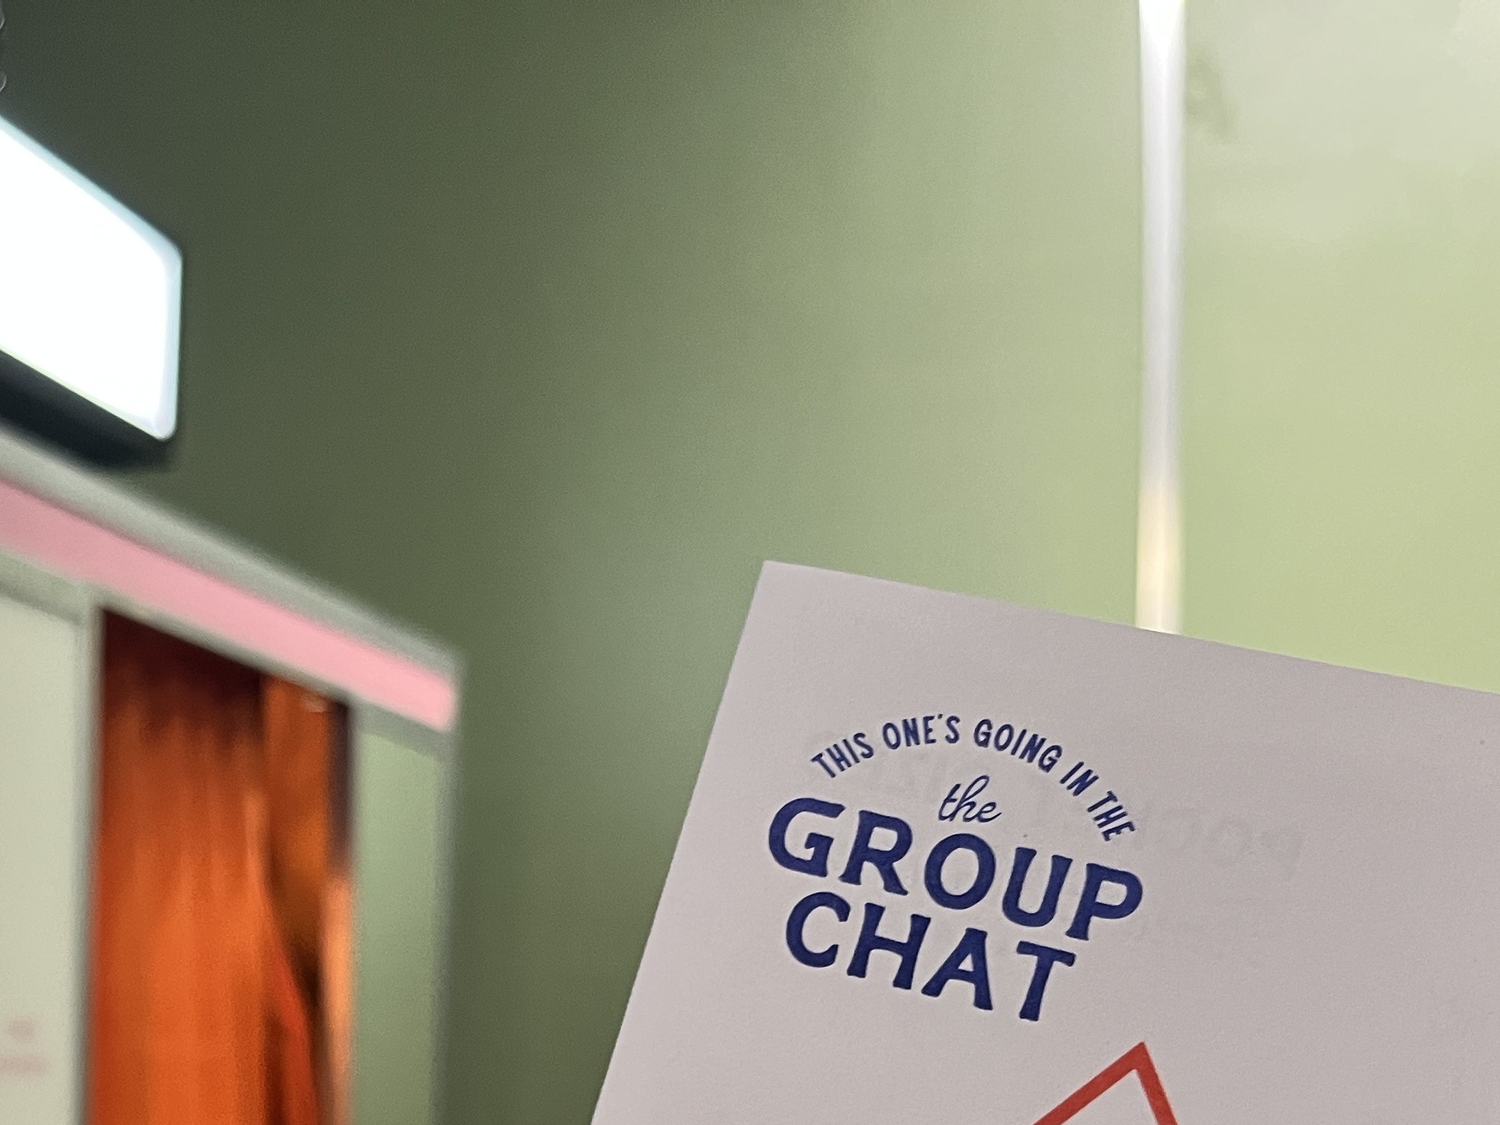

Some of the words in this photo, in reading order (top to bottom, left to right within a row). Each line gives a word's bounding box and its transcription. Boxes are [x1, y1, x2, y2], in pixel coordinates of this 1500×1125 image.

[811, 732, 874, 780] THIS
[882, 713, 960, 751] ONE'S
[973, 718, 1063, 773] GOING
[1060, 761, 1098, 797] IN
[1086, 789, 1137, 842] THE
[937, 774, 1002, 824] the
[767, 796, 1144, 942] GROUP
[785, 891, 1077, 1022] CHAT
